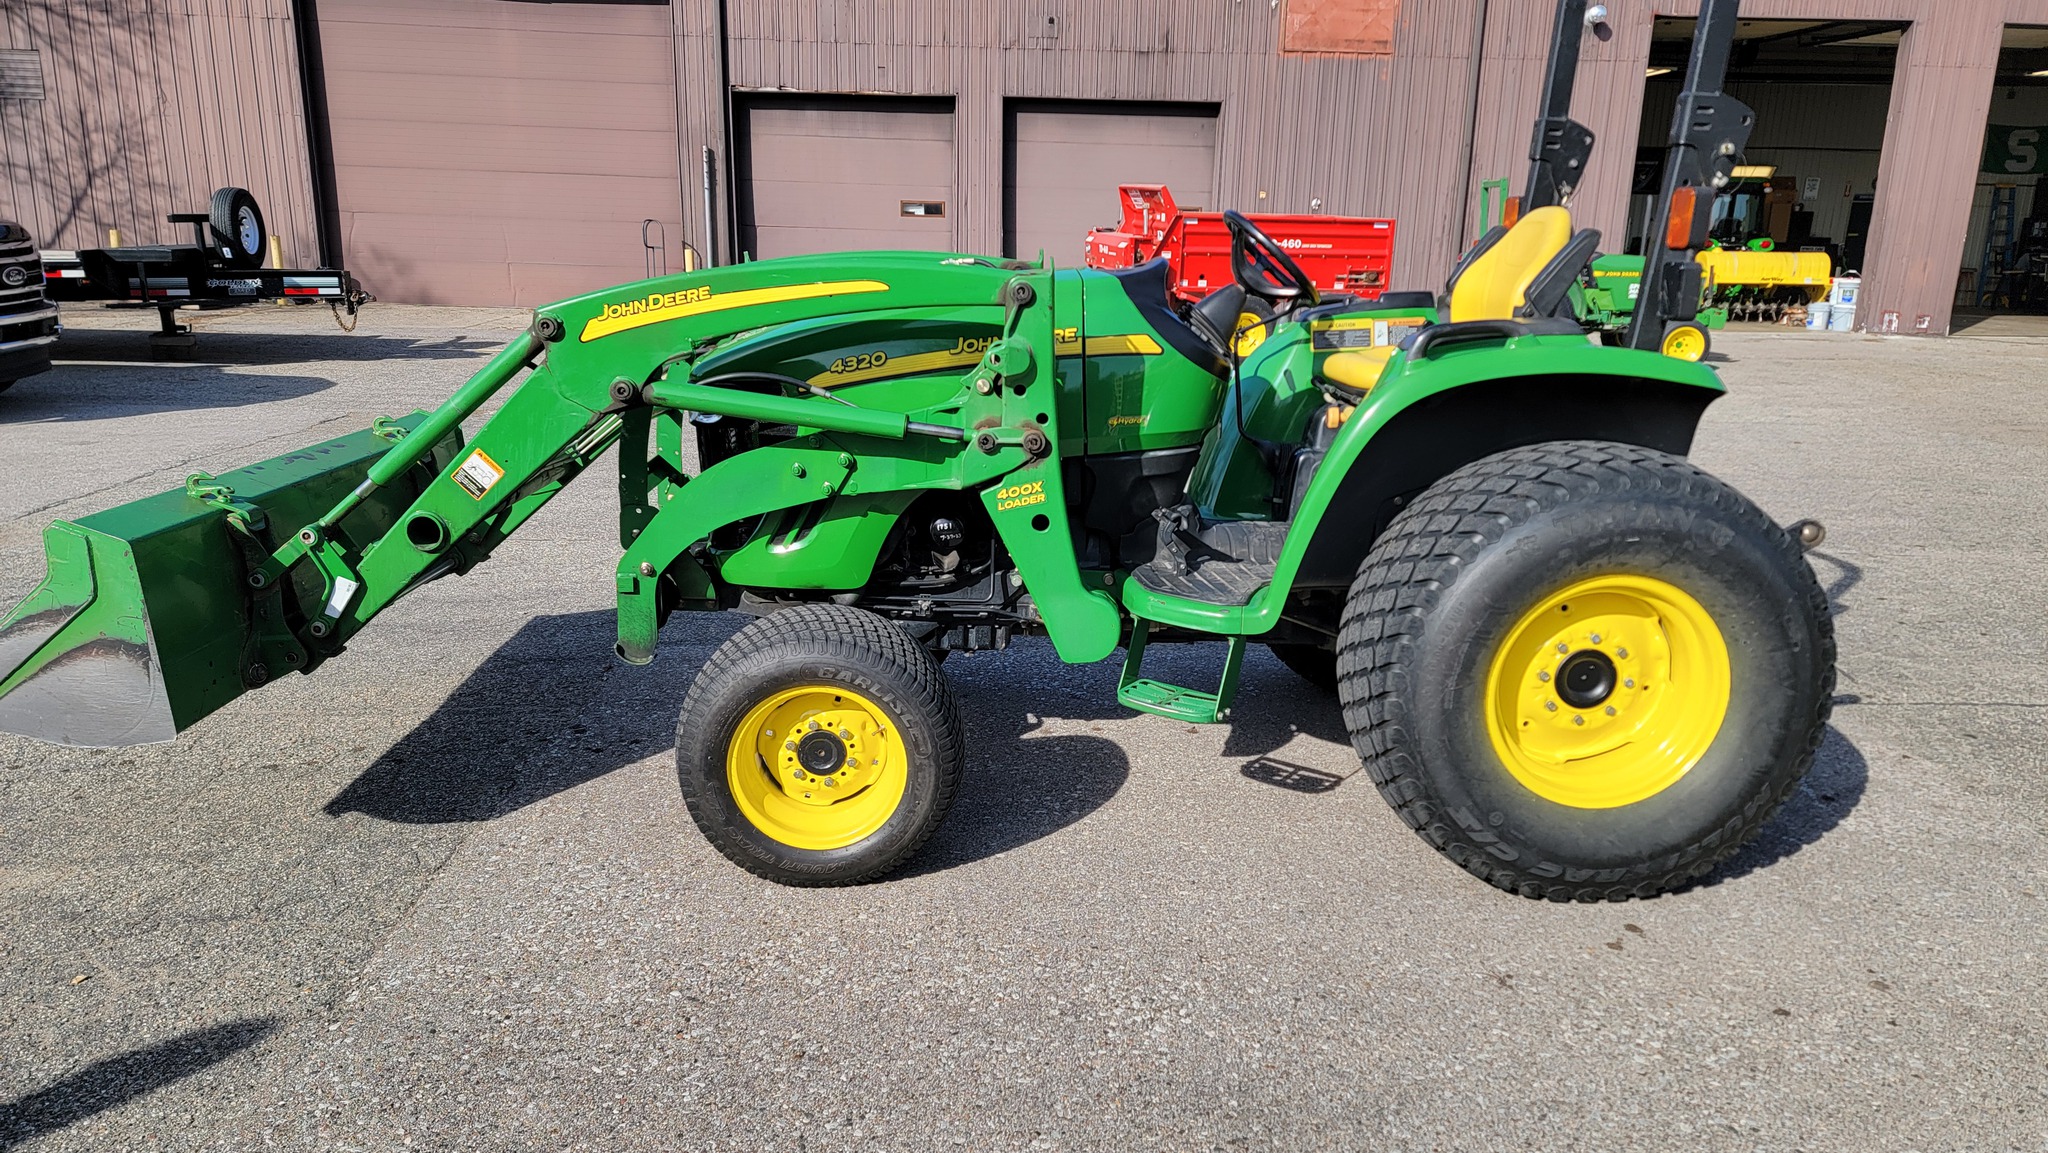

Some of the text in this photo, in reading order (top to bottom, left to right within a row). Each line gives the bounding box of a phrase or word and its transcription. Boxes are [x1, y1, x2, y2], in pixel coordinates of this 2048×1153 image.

[2004, 130, 2040, 172] S
[207, 279, 261, 287] GOLDEN
[597, 285, 711, 321] JOHN DEERE
[830, 351, 887, 375] 4320
[997, 481, 1044, 501] 400X
[997, 494, 1046, 511] LOADER
[818, 667, 919, 742] CARLISLE
